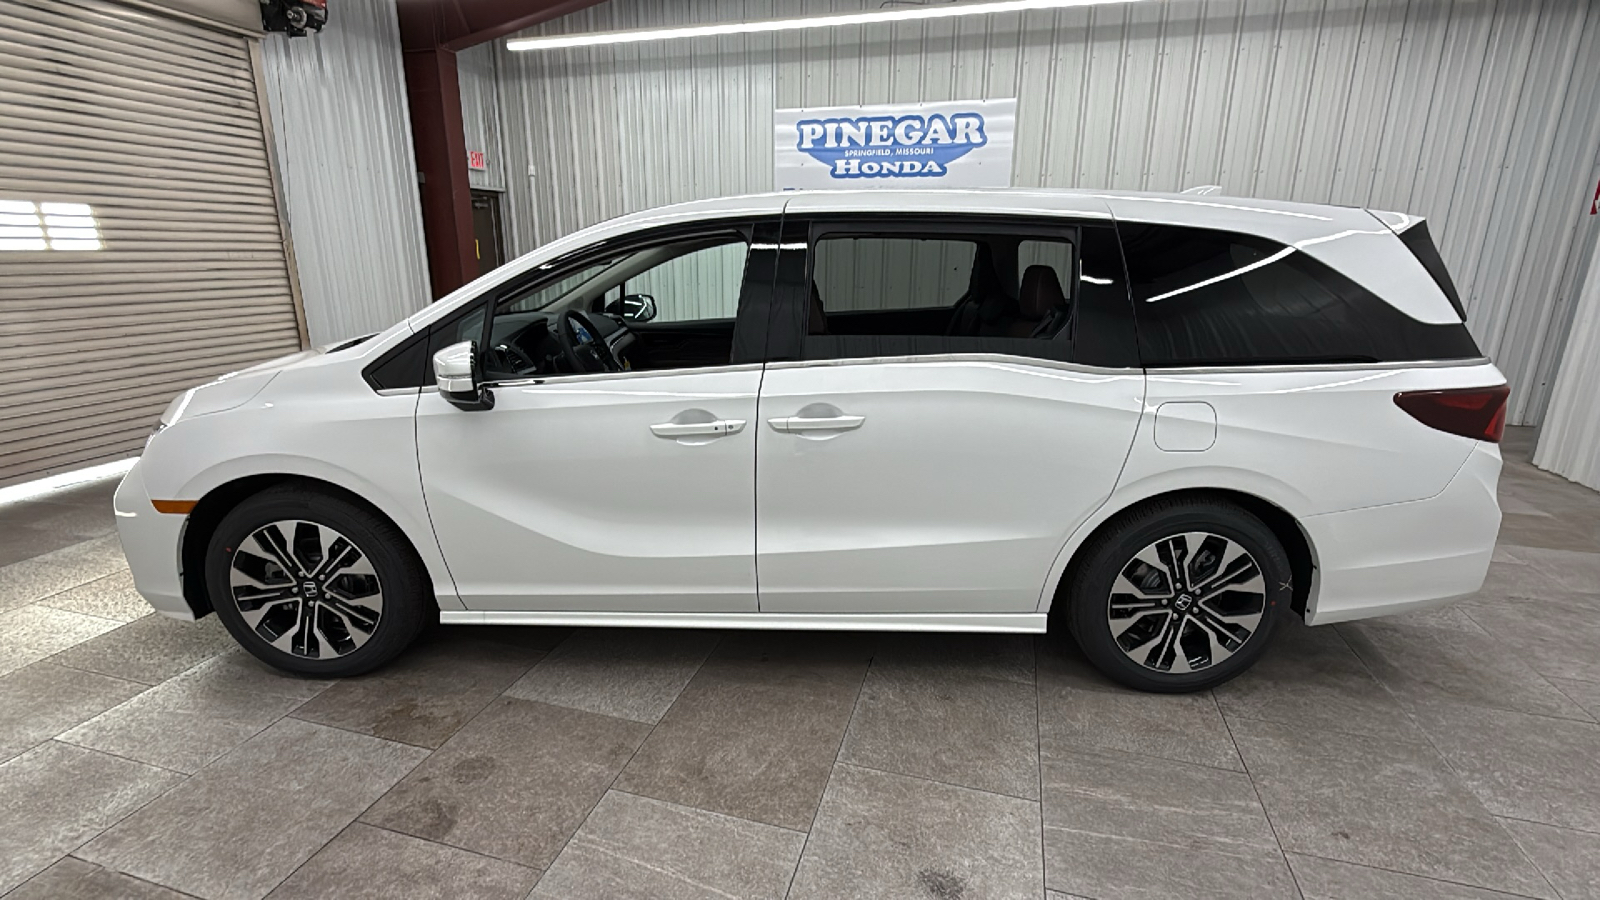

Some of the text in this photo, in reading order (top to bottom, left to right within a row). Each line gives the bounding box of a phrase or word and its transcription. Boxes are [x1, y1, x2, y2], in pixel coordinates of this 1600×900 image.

[800, 117, 983, 149] PINEGAR
[470, 151, 484, 168] EXIT
[844, 147, 934, 158] SPRINGFIELD, MISSOURI
[835, 159, 943, 175] HONDA
